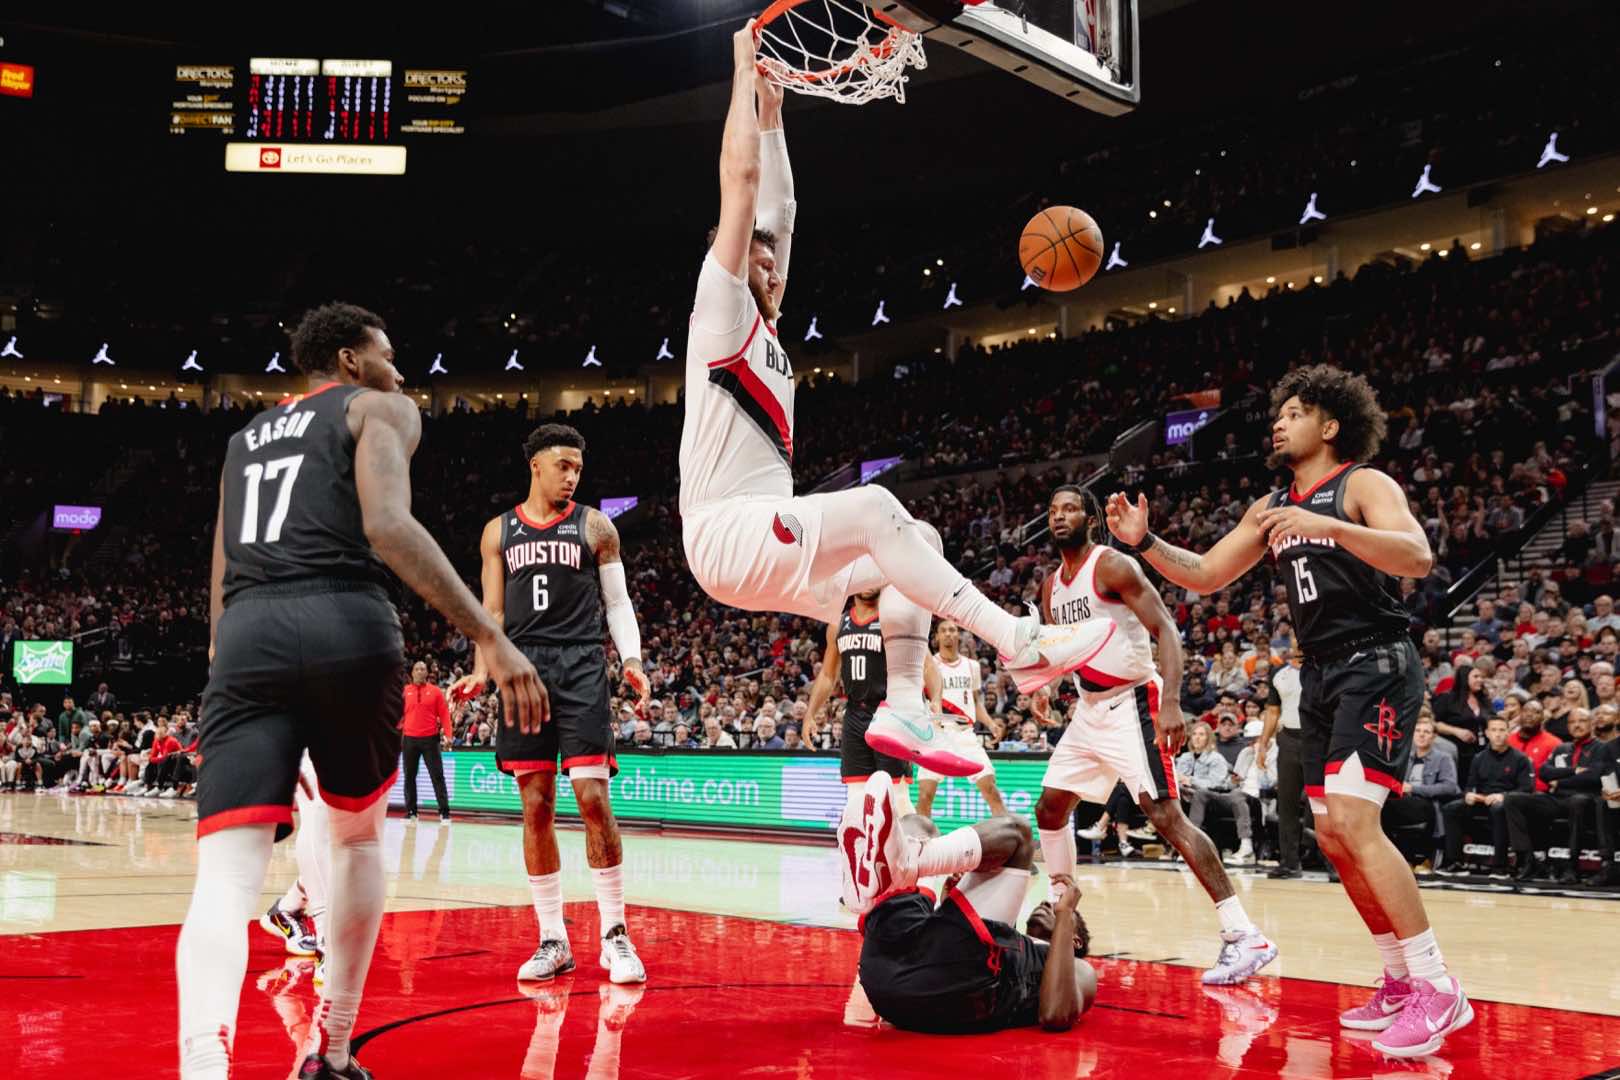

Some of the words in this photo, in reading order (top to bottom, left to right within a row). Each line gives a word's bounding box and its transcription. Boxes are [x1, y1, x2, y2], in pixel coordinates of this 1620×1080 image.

[405, 72, 466, 85] DIRECTORS
[315, 155, 333, 165] Go
[244, 410, 316, 451] EASON
[239, 453, 305, 545] 17
[505, 540, 581, 574] HOUSTON
[532, 574, 549, 611] 6
[1290, 555, 1318, 605] 15
[837, 633, 882, 654] HOUSTON
[19, 652, 65, 671] Sprite
[850, 655, 867, 681] 10
[619, 767, 761, 806] chime.com
